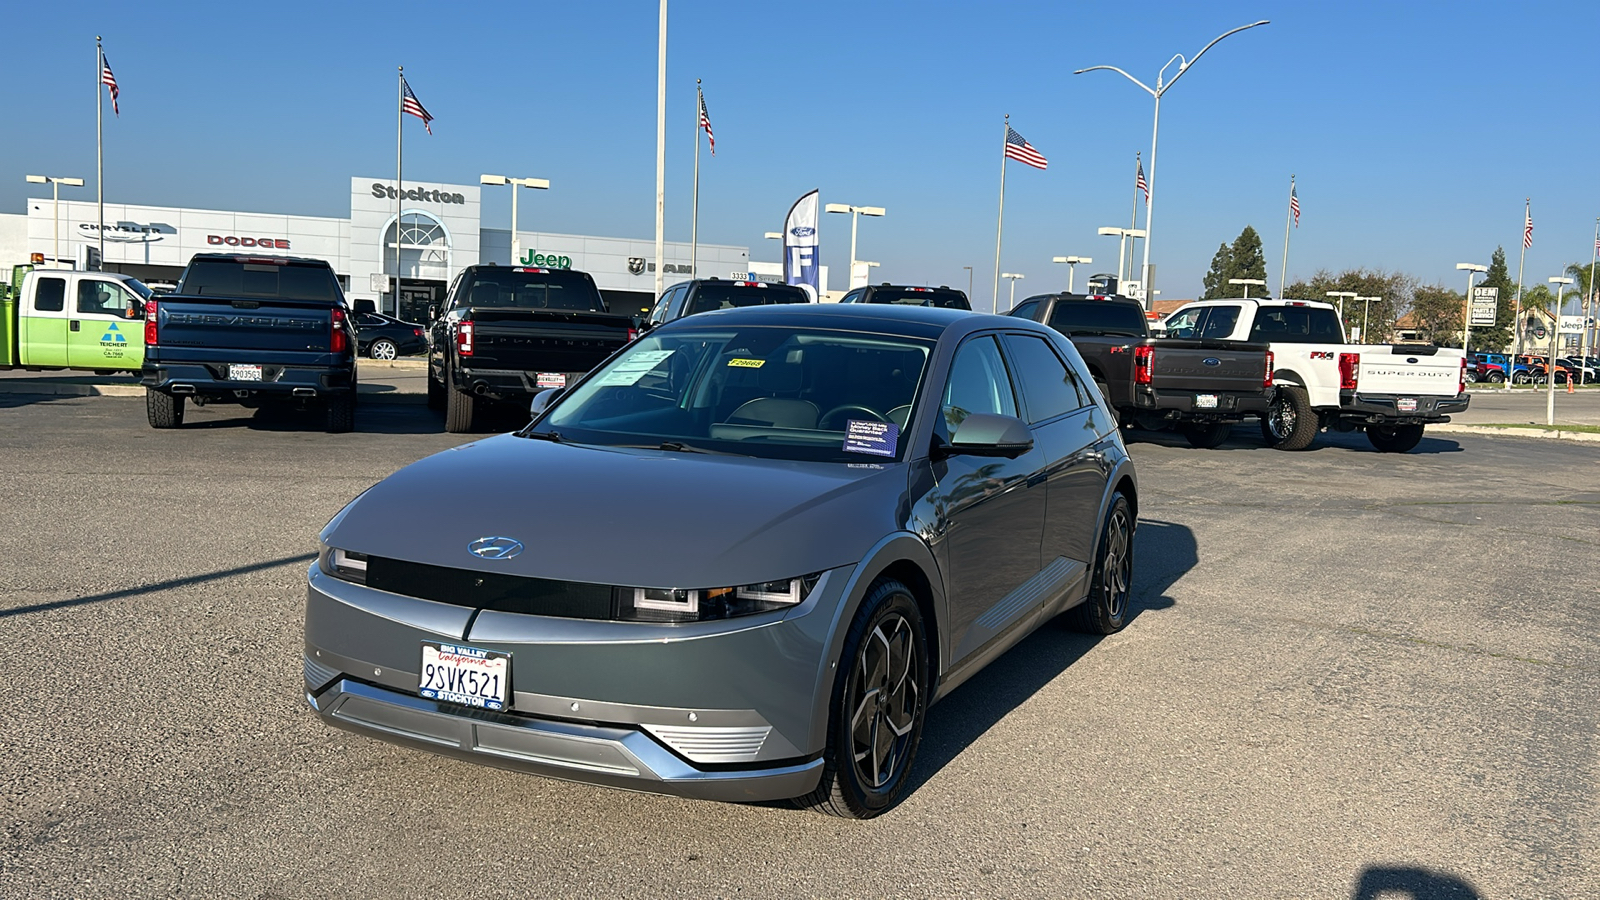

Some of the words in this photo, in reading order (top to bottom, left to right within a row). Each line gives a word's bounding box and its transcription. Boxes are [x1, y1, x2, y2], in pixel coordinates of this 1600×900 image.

[372, 183, 464, 204] Stockton
[79, 223, 161, 234] CHRYSLER
[794, 227, 813, 237] Ford
[207, 235, 290, 249] DODGE
[520, 249, 570, 268] Jeep
[732, 272, 747, 280] 3333
[1474, 288, 1496, 297] OEM
[169, 314, 321, 328] CHEVROLET
[1561, 321, 1582, 330] Jeep
[500, 338, 604, 347] PLATINUM
[1310, 351, 1334, 359] FX4
[440, 645, 455, 653] BIG
[456, 647, 487, 658] VALLEY
[438, 651, 492, 667] California
[425, 664, 500, 700] 9SVK521
[437, 691, 485, 707] STOCKTON
